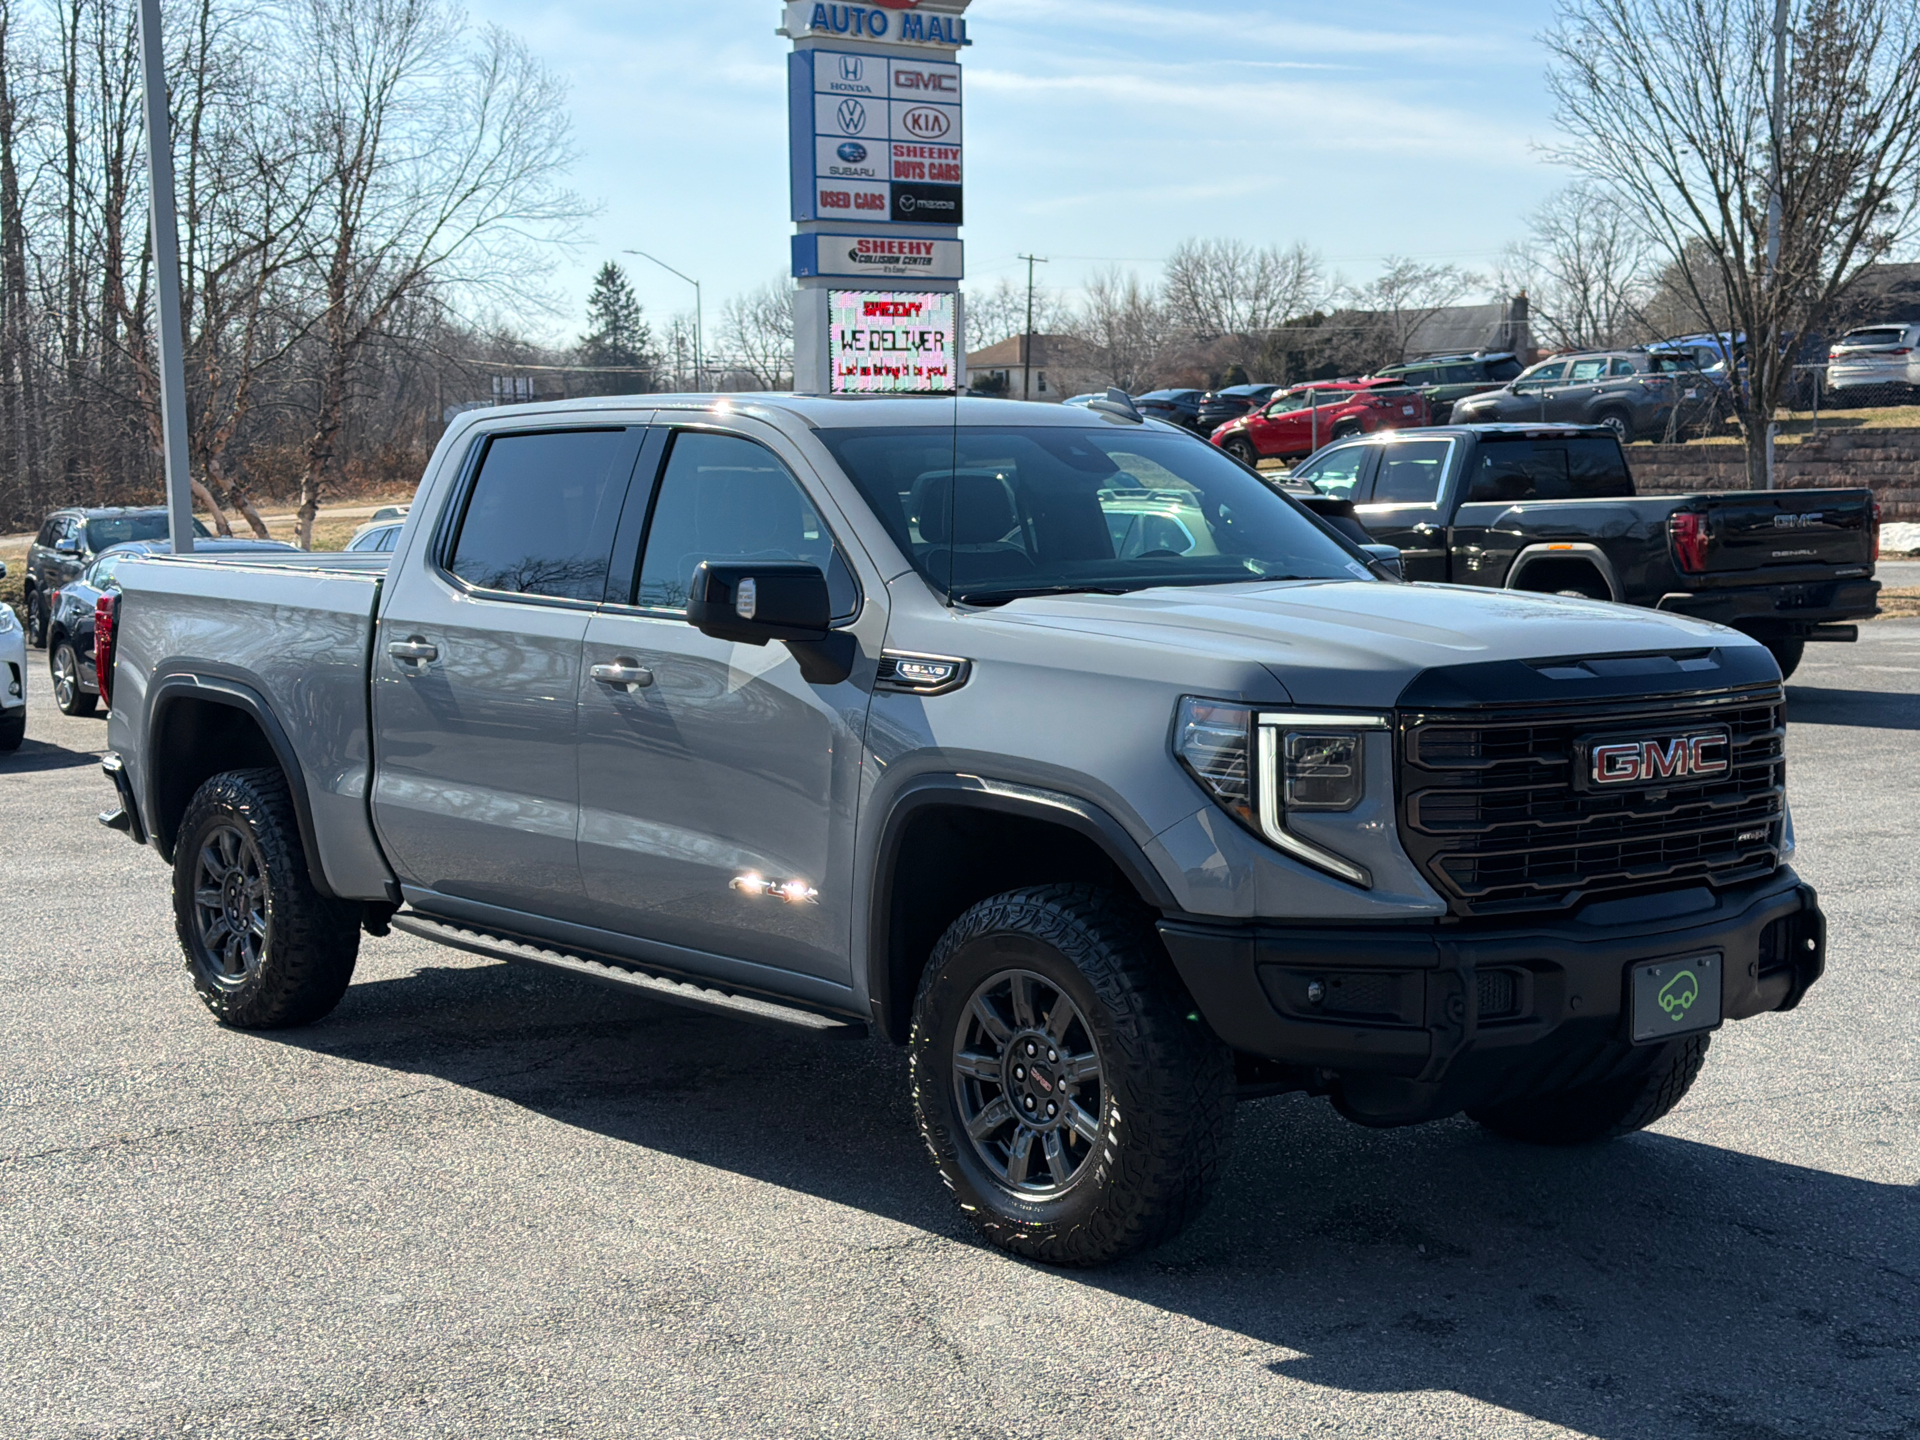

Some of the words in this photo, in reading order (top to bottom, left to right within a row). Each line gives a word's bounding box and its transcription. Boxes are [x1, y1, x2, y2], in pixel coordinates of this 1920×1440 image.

[811, 3, 888, 36] AUTO
[902, 13, 972, 46] MALL
[830, 82, 872, 93] HONDA
[895, 70, 957, 93] GMC
[912, 114, 942, 132] KIA
[893, 145, 960, 160] SHEEHY
[829, 166, 875, 177] SUBARU
[894, 161, 925, 179] BUYS
[929, 163, 960, 182] CARS
[820, 190, 851, 209] USED
[855, 193, 885, 210] CARS
[857, 239, 934, 255] SHEEHY
[858, 255, 901, 265] COLLISION
[902, 256, 933, 266] CENTER
[841, 330, 866, 351] WE
[870, 330, 944, 351] DELIVER
[1774, 513, 1823, 528] GMC
[1772, 549, 1817, 557] DENALI
[1592, 734, 1728, 783] GMC
